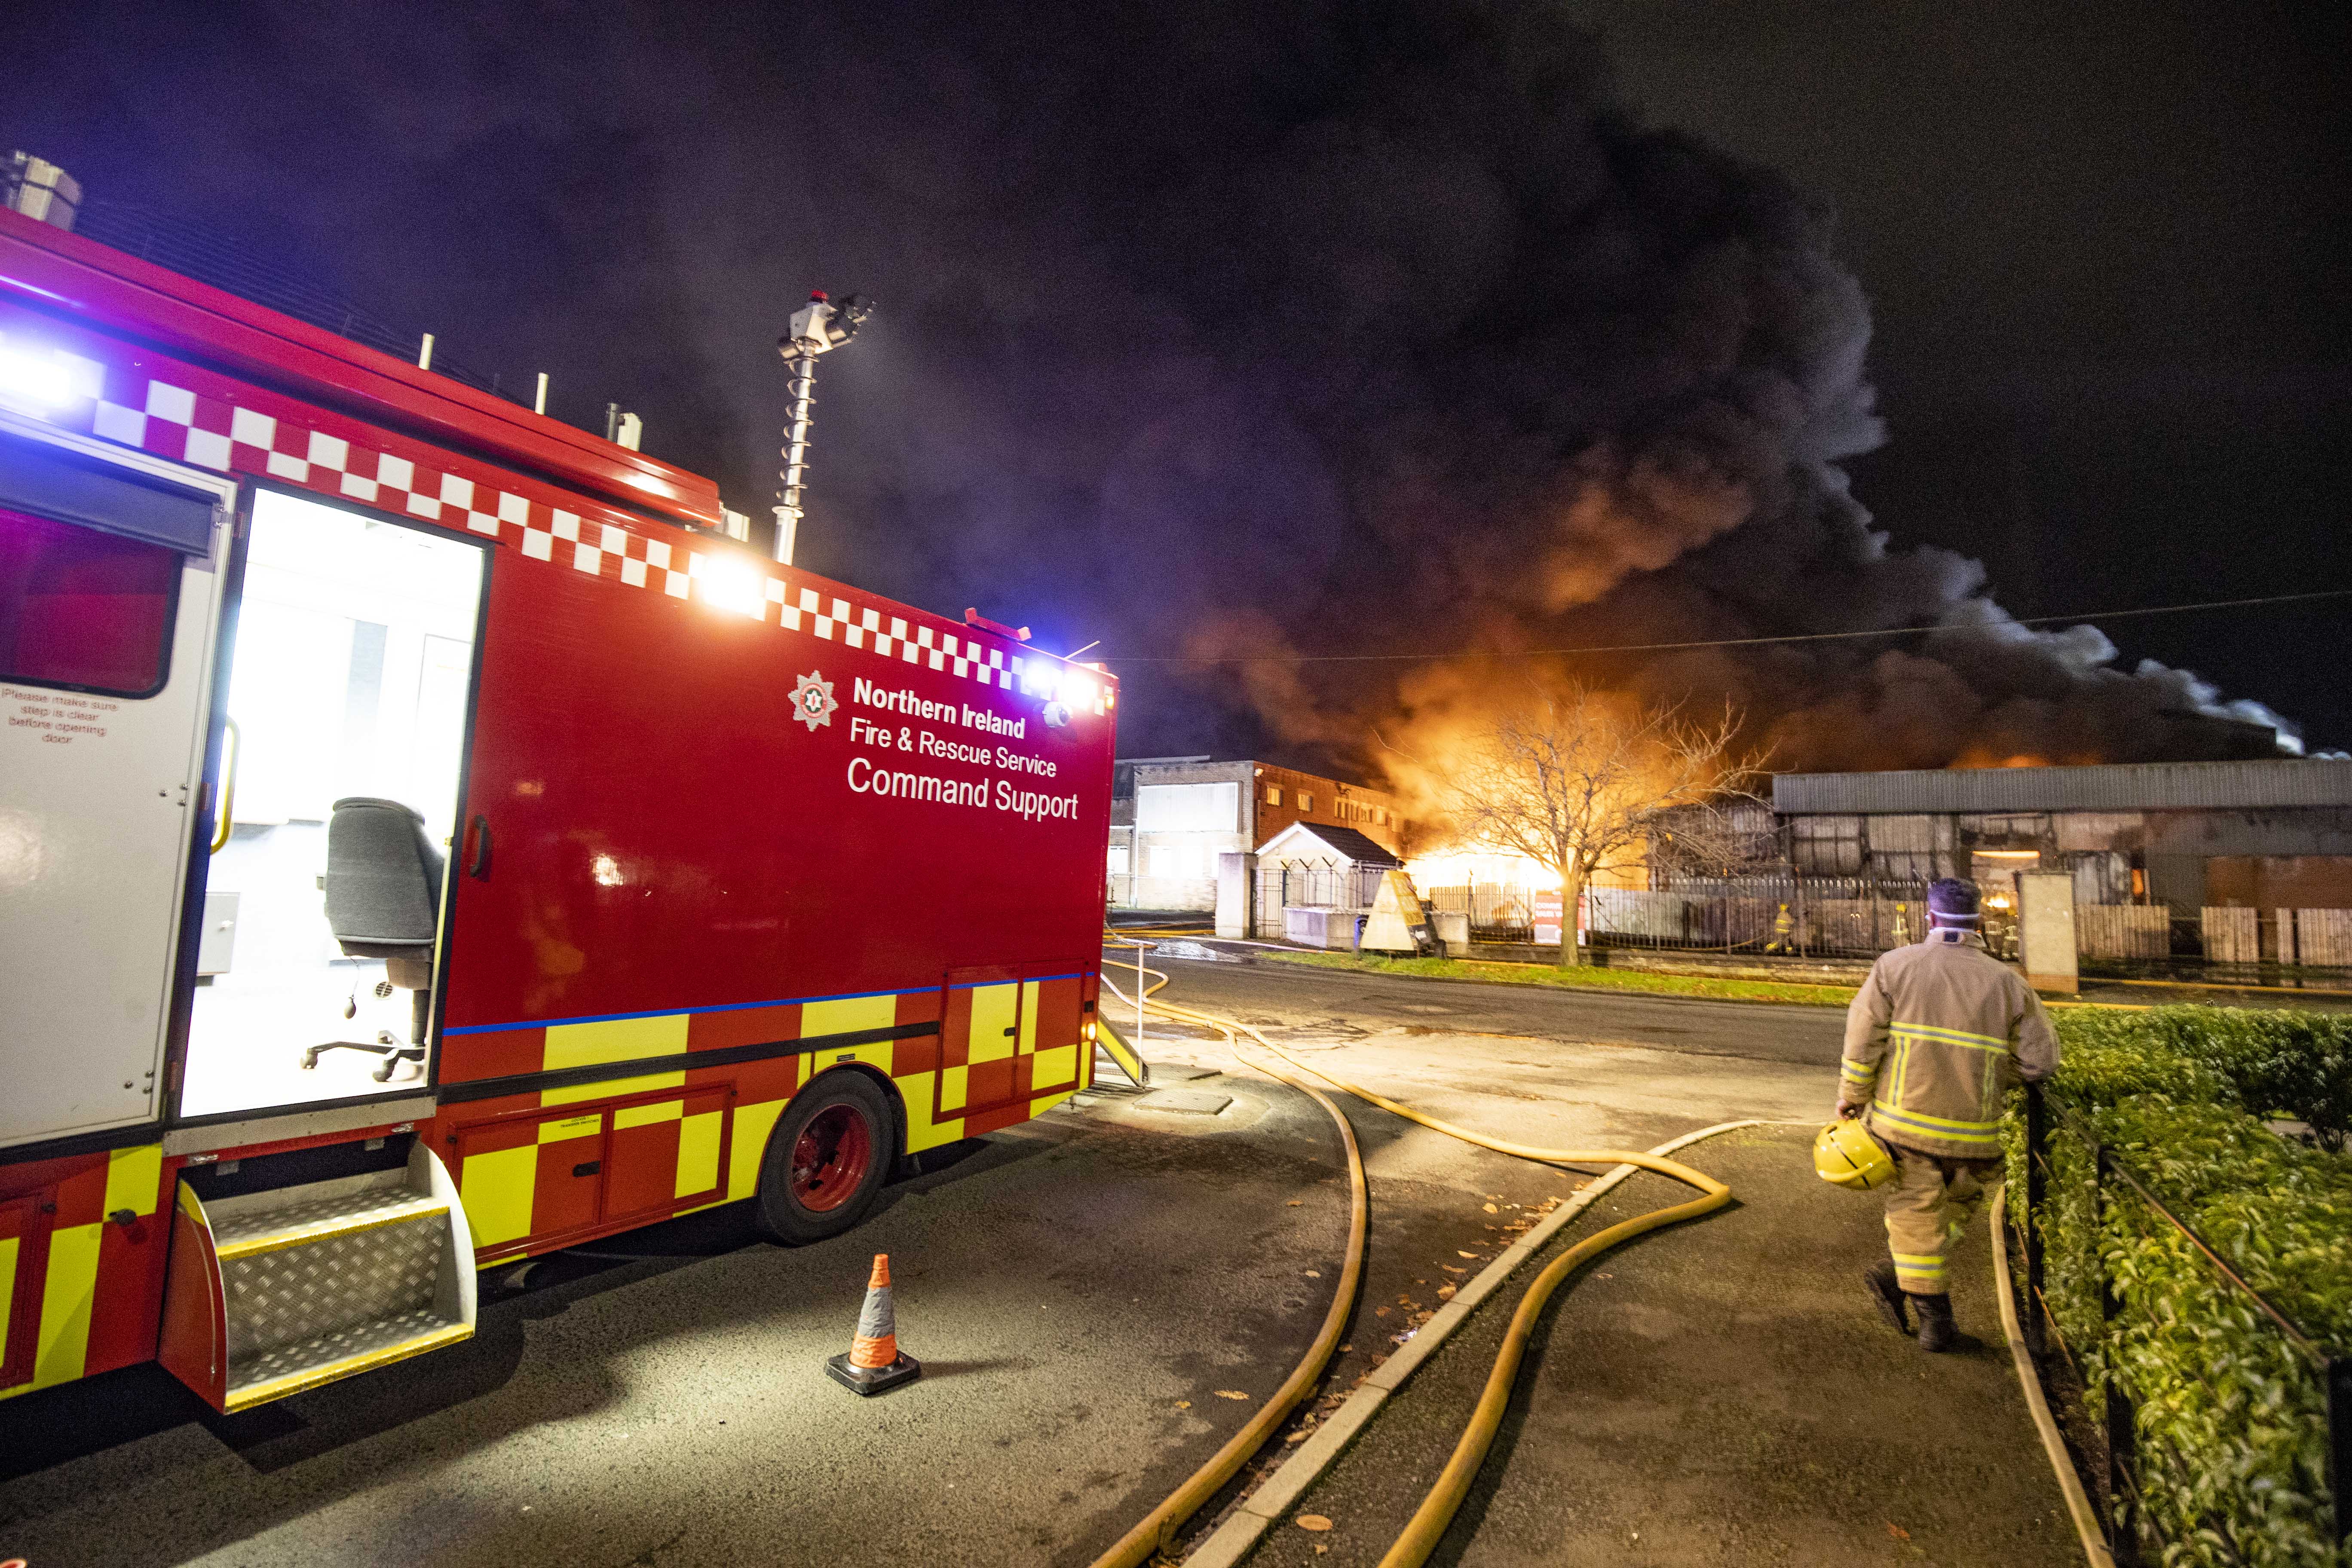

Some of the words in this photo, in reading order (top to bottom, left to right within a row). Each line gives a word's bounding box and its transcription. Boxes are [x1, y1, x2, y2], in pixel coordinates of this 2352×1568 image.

[2, 688, 48, 703] Please
[52, 697, 88, 707] make
[91, 701, 118, 711] sure
[854, 677, 956, 724] Northern
[962, 703, 1025, 739] Ireland
[21, 706, 50, 717] step
[53, 709, 64, 717] is
[67, 711, 99, 721] clear
[9, 716, 52, 729] before
[55, 723, 107, 737] opening
[42, 733, 73, 743] door
[850, 717, 892, 747] Fire
[897, 727, 913, 752] &
[919, 731, 992, 765] Rescue
[995, 747, 1057, 777] Service
[848, 757, 989, 808] Command
[995, 780, 1078, 822] Support
